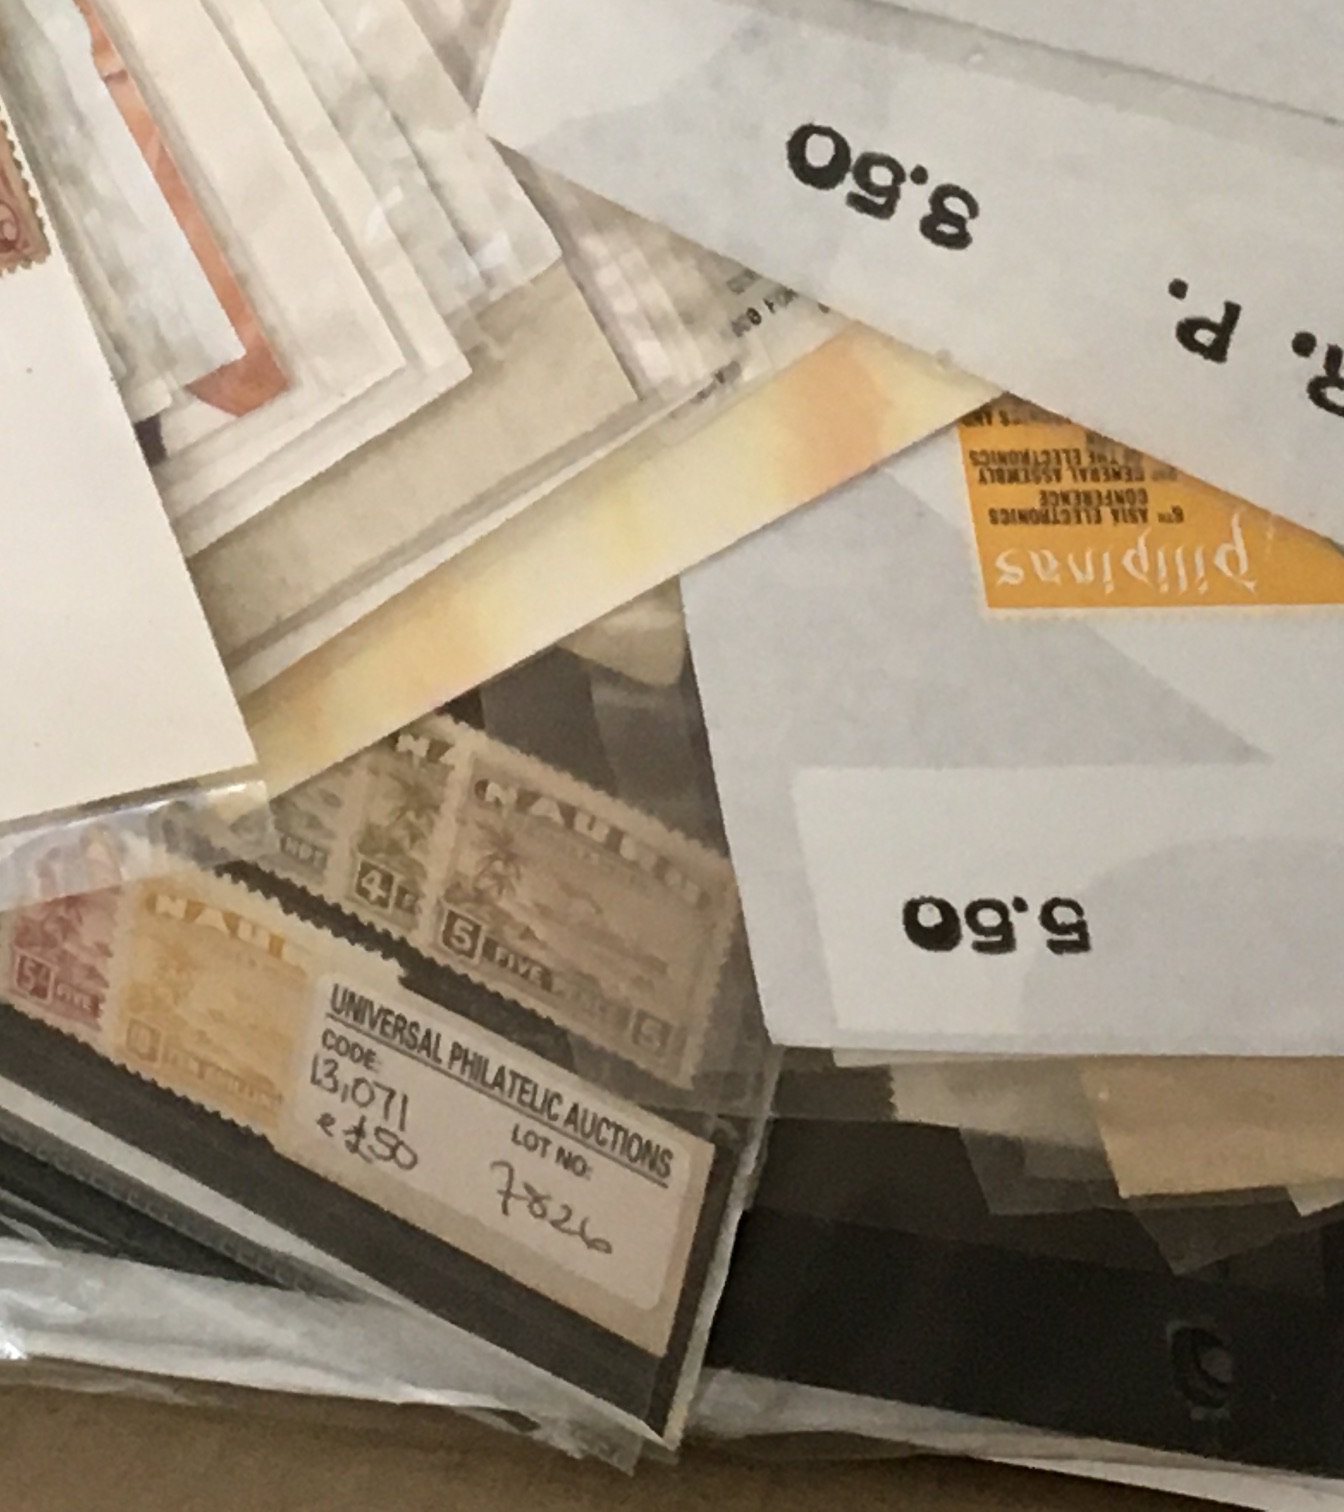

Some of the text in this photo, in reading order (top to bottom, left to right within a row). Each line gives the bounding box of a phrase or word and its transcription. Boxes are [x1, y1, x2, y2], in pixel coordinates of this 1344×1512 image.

[786, 123, 979, 249] 3.50
[1168, 278, 1242, 362] P.
[969, 449, 1081, 466] ELECTRONICS
[978, 467, 1061, 484] ASSEMBLY
[1039, 488, 1148, 507] CONFERENCE
[987, 507, 1101, 526] ELECTRONICS
[1110, 507, 1148, 525] ASIA
[903, 894, 1091, 954] 5.50
[329, 985, 673, 1177] UNIVERSAL PHILATELIC AUCTIONS
[512, 1127, 553, 1156] LOT
